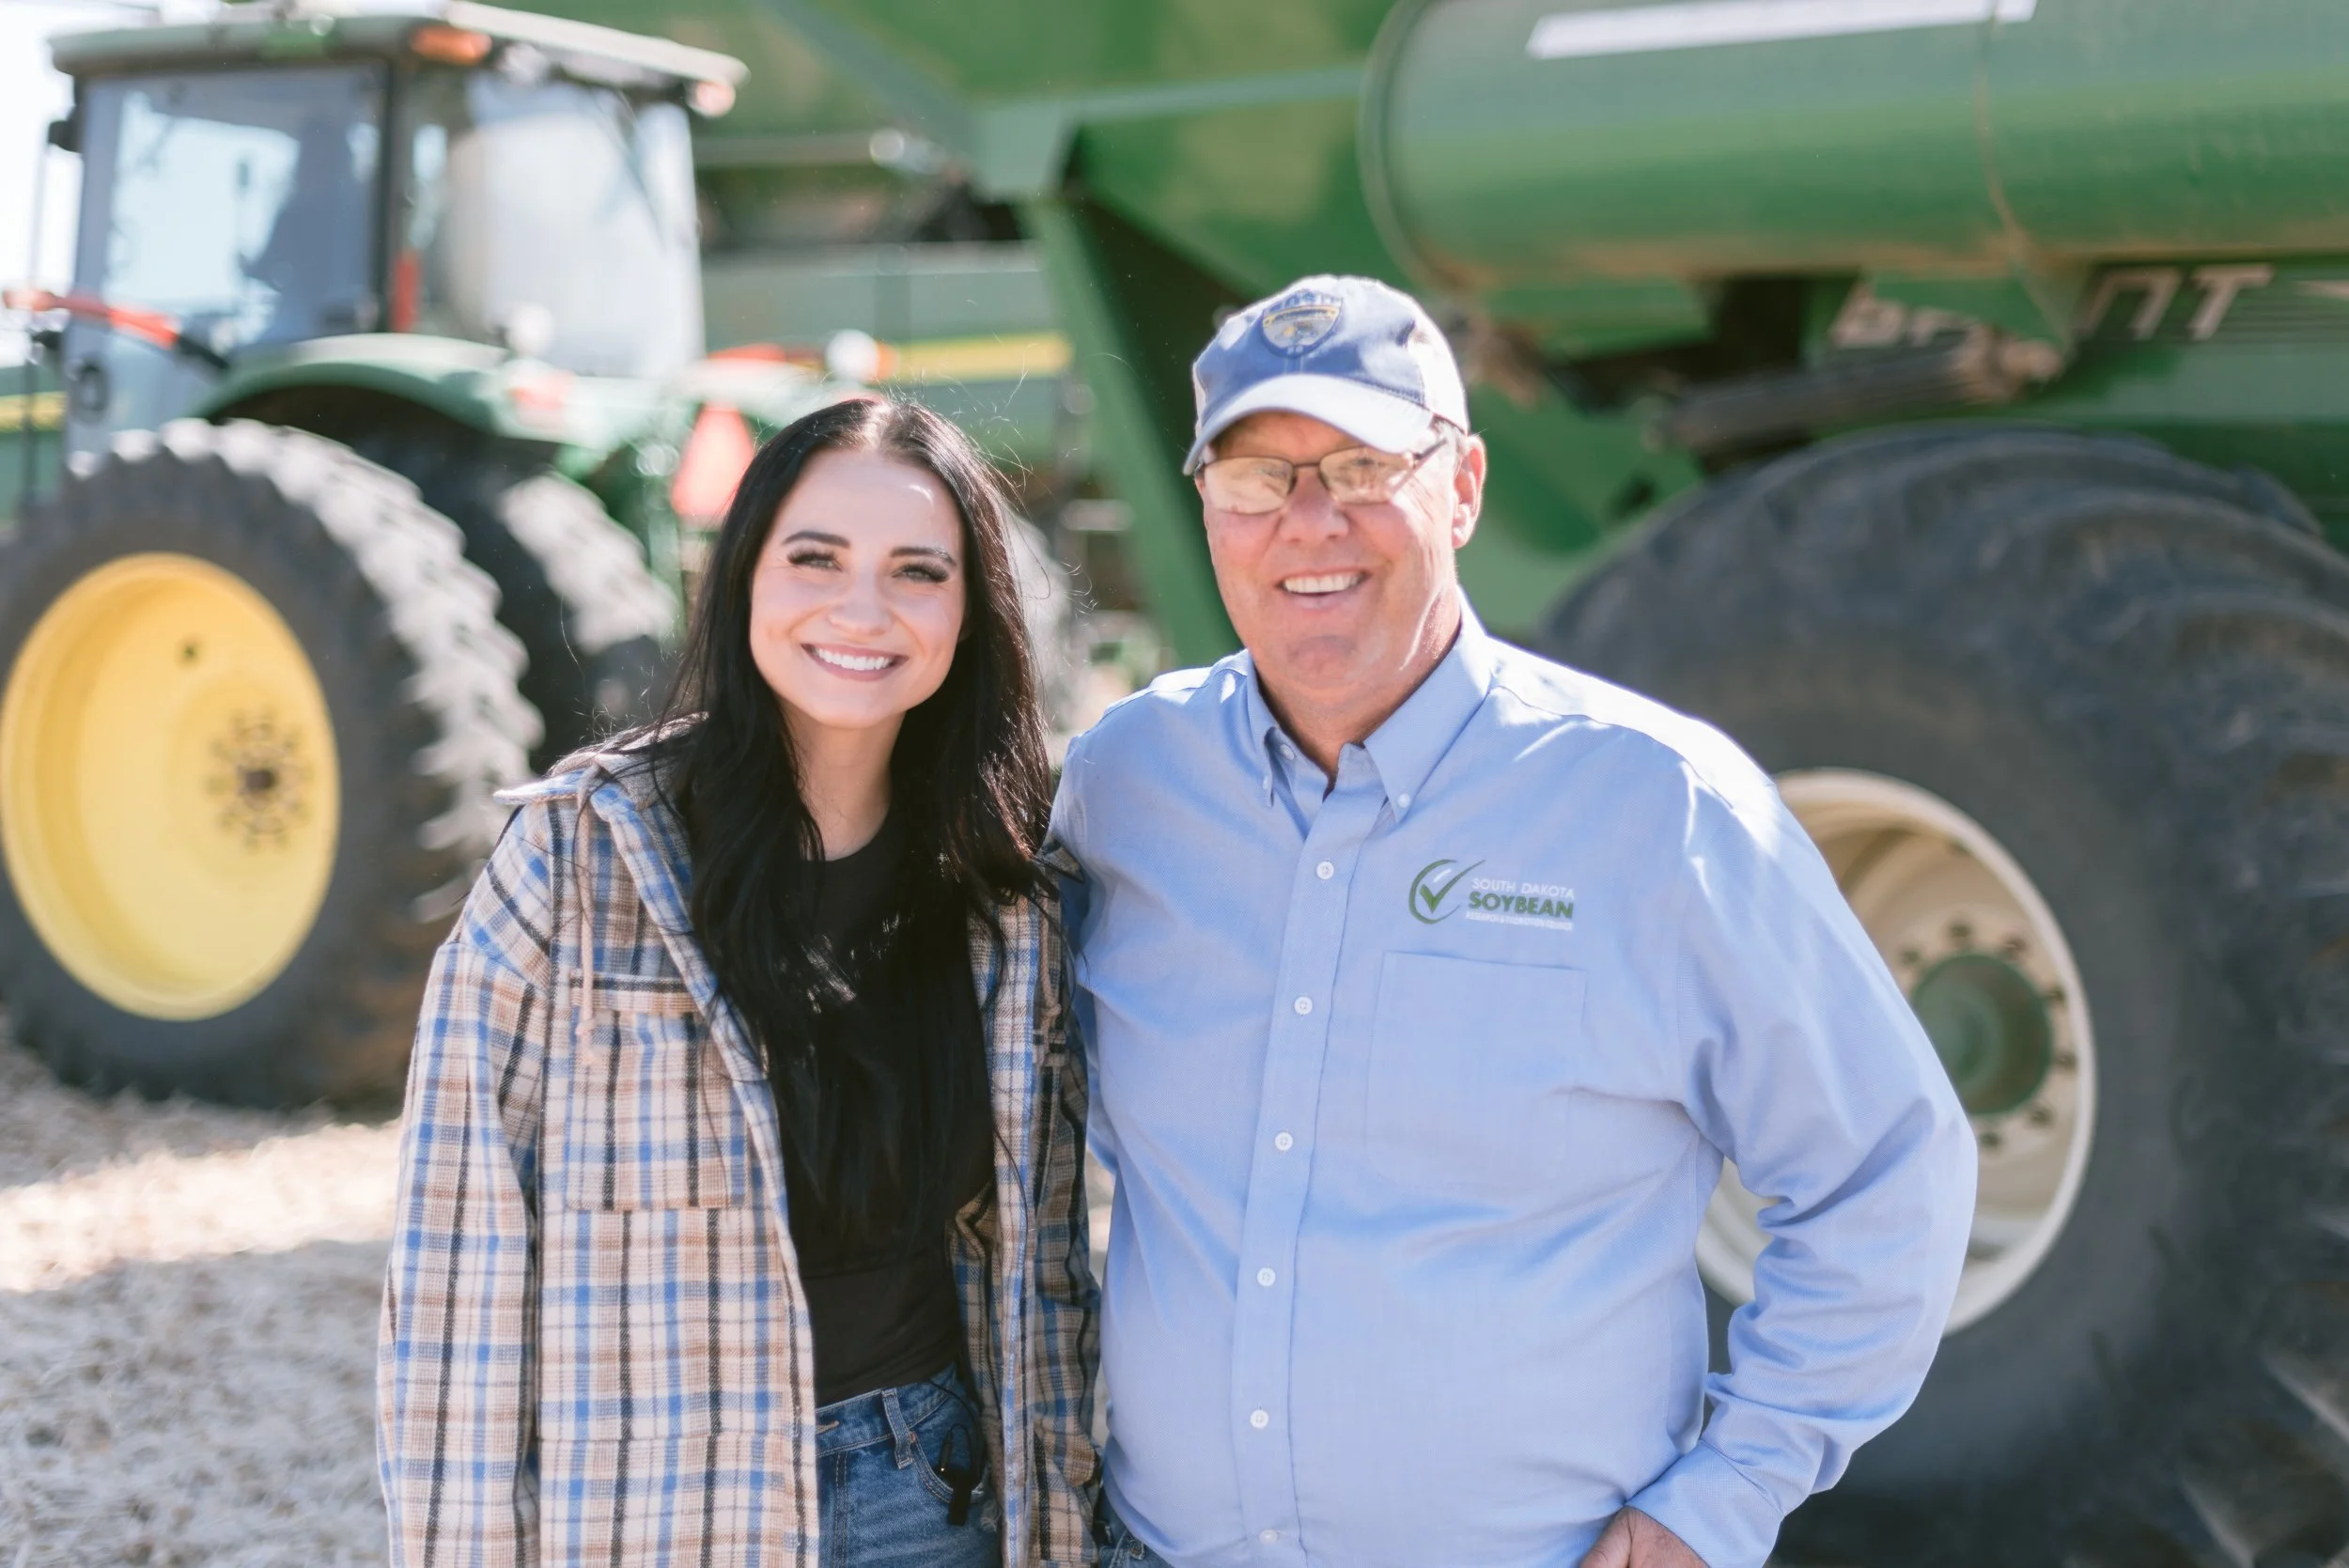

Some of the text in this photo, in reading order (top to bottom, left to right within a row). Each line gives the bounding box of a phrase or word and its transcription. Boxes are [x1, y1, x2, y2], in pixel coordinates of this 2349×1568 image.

[1472, 878, 1574, 899] SOUTH DAKOTA
[1469, 892, 1574, 918] SOYBEAN
